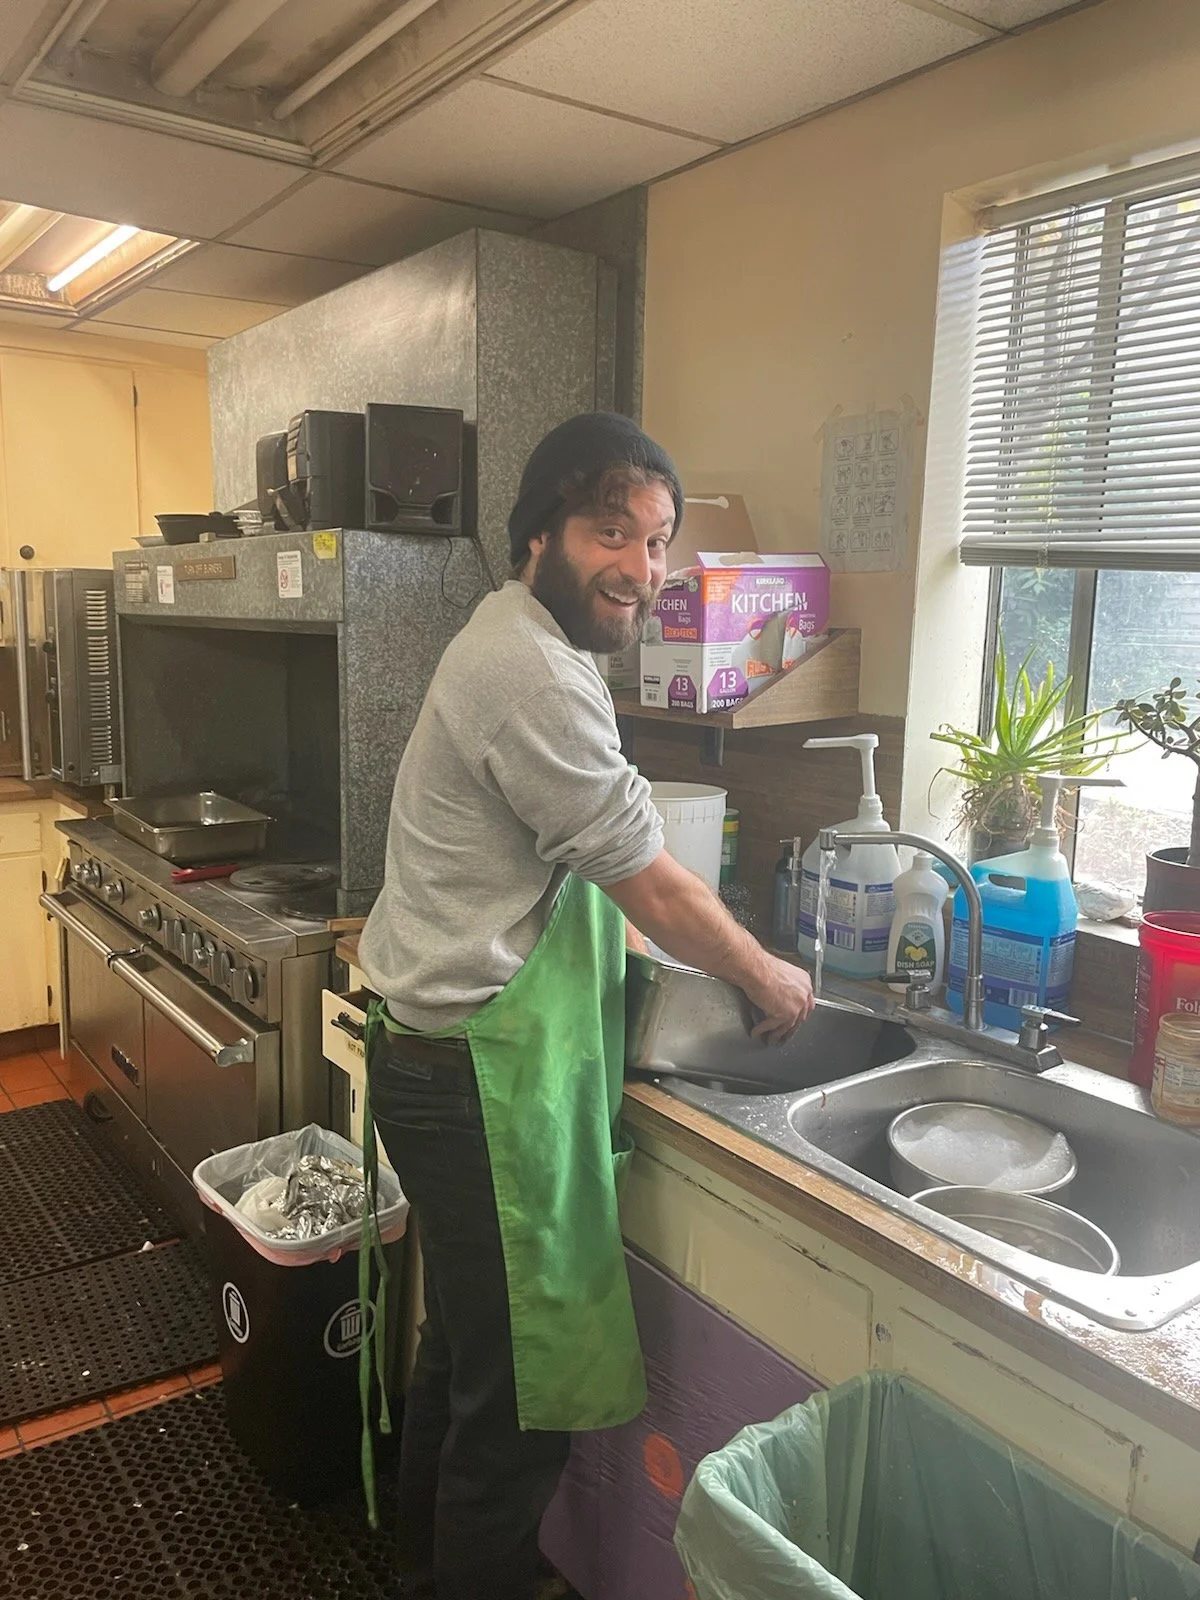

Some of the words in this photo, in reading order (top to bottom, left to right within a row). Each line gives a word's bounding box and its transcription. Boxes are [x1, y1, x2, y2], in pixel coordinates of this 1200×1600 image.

[731, 592, 808, 613] KITCHEN
[798, 619, 815, 633] Bags
[676, 677, 688, 691] 13
[719, 671, 737, 688] 13
[681, 700, 694, 708] BAGS
[711, 700, 724, 708] 200
[896, 960, 914, 968] DISH
[915, 960, 935, 969] SOAP
[1176, 997, 1200, 1014] Fol
